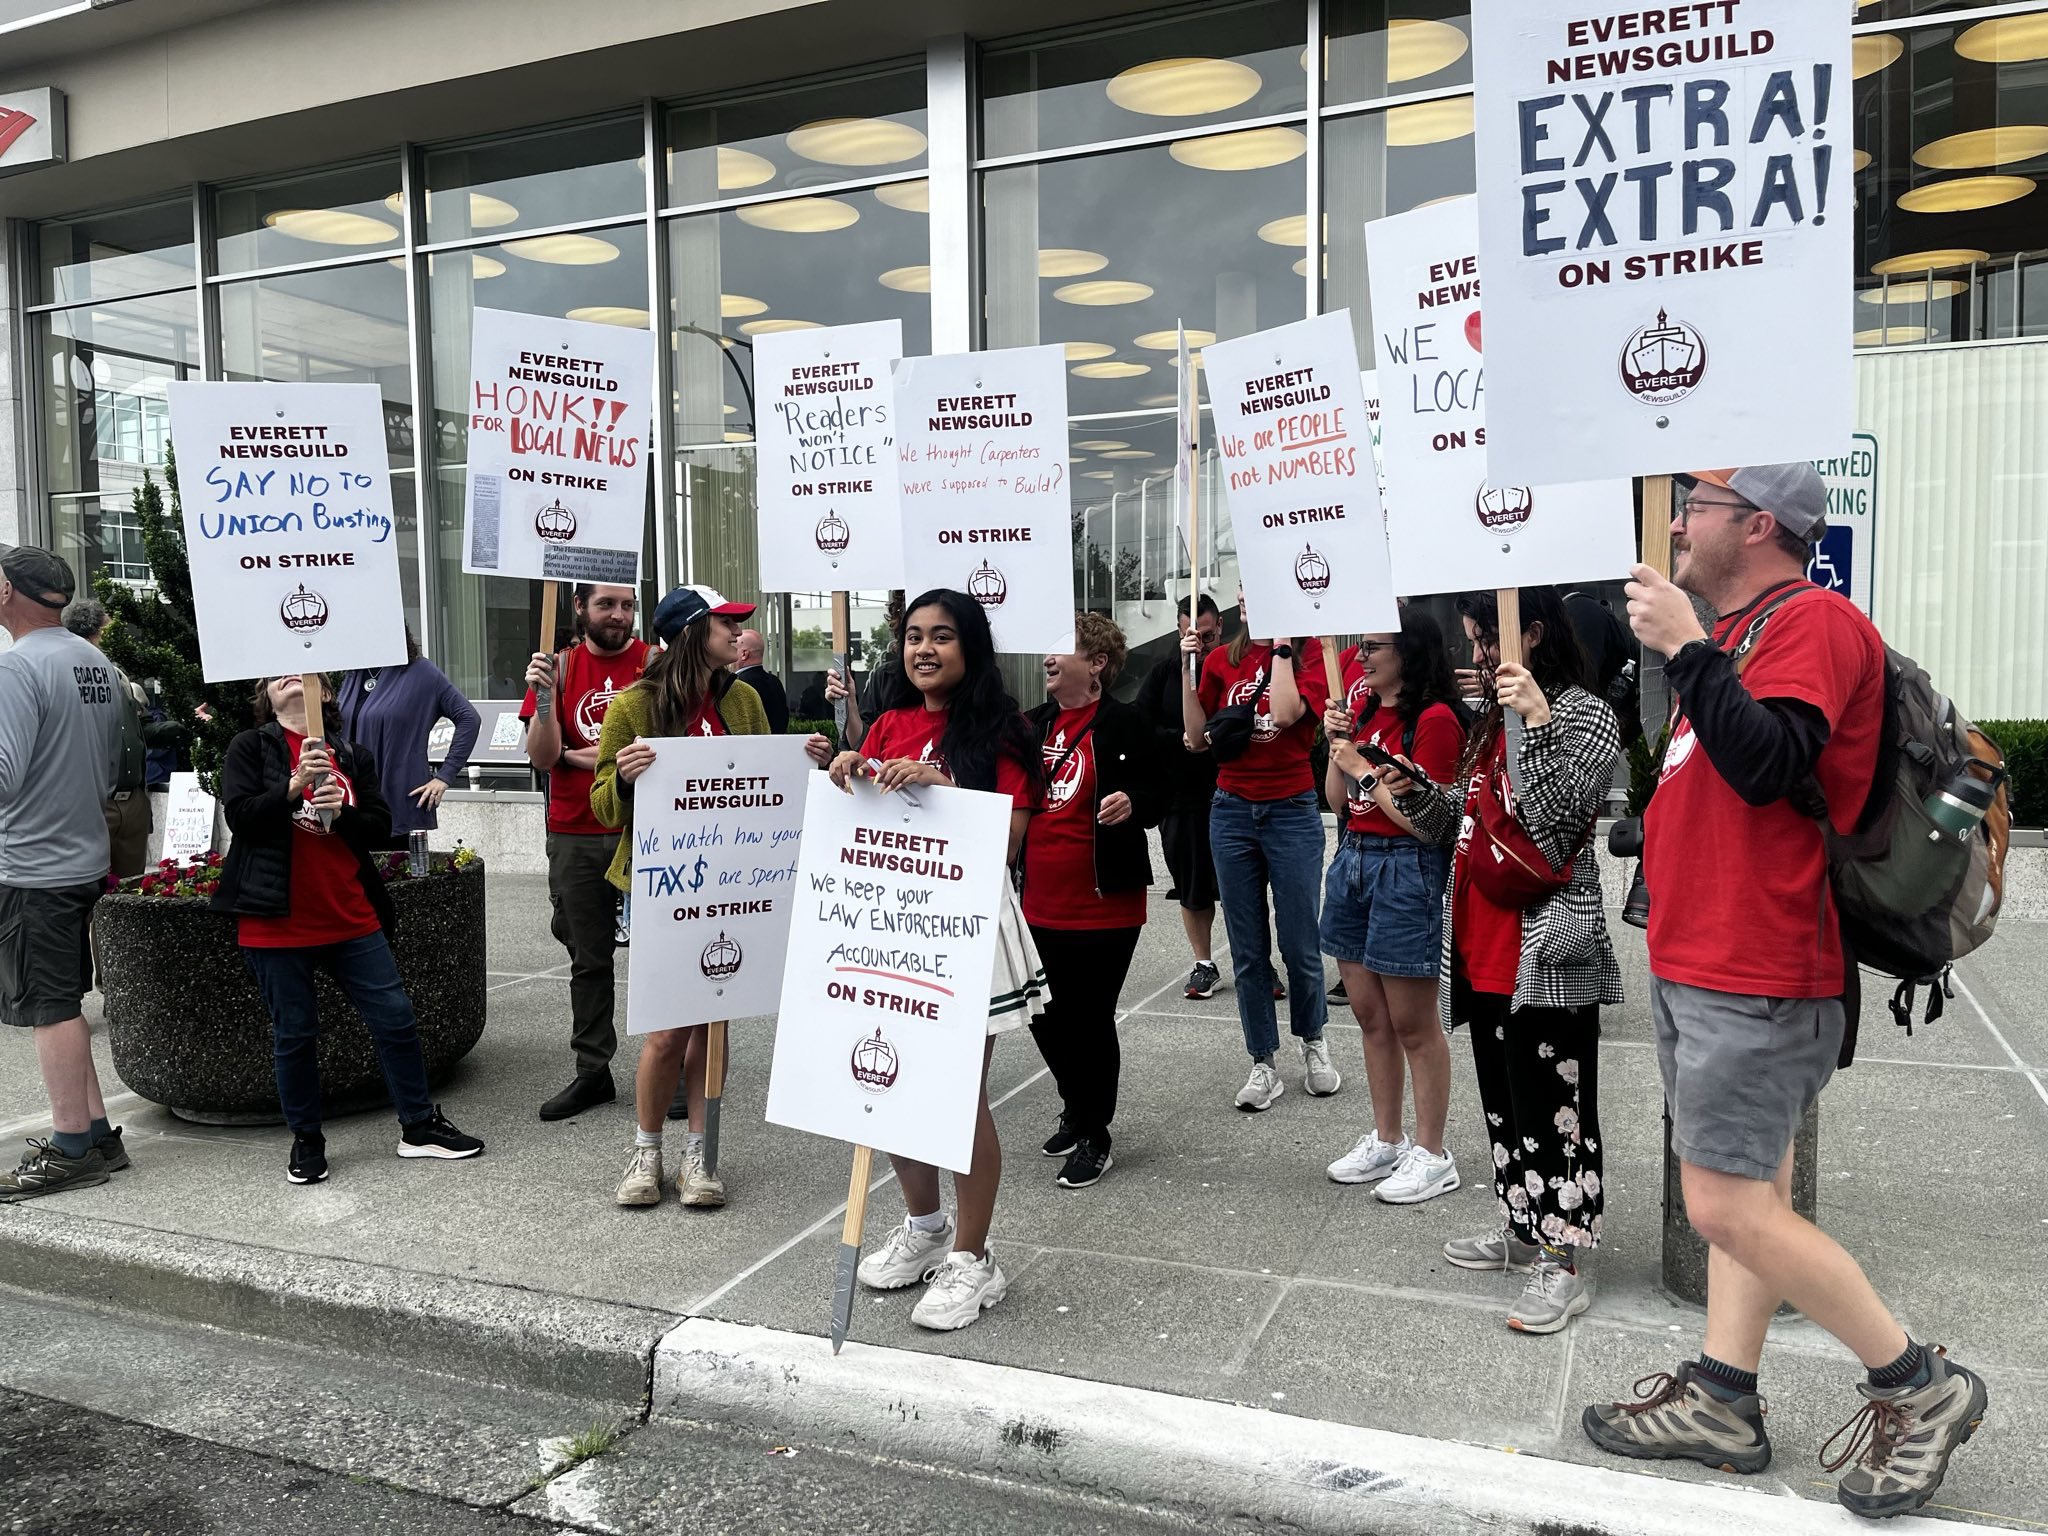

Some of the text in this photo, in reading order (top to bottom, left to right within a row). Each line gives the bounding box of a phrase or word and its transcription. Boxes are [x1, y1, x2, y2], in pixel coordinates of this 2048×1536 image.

[1567, 0, 1740, 47] EVERETT
[1547, 30, 1774, 84] NEWSGUILD
[1518, 63, 1832, 175] EXTRA!
[1522, 144, 1832, 256] EXTRA!
[1559, 241, 1763, 288] ON STRIKE
[1384, 322, 1439, 365] WE
[520, 351, 604, 374] EVERETT
[792, 362, 860, 380] EVERETT
[508, 366, 618, 392] NEWSGUILD
[784, 377, 874, 397] NEWSGUILD
[1245, 368, 1314, 395] EVERETT
[1635, 373, 1693, 389] EVERETT
[475, 380, 629, 433] HONK!!
[937, 394, 1017, 412] EVERETT
[1240, 385, 1331, 416] NEWSGUILD
[1641, 388, 1687, 403] NEWSGUILD
[472, 415, 505, 432] FOR
[928, 412, 1033, 431] NEWSGUILD
[230, 427, 328, 440] EVERETT
[1222, 435, 1247, 459] We
[1254, 429, 1275, 450] are
[1277, 408, 1345, 443] PEOPLE
[1432, 431, 1466, 452] ON
[220, 444, 348, 459] NEWSGUILD
[899, 443, 918, 463] We
[926, 443, 972, 468] thought
[508, 468, 608, 491] ON STRIKE
[1231, 469, 1262, 490] not
[1268, 447, 1357, 485] NUMBERS
[206, 466, 276, 502] SAY
[290, 472, 330, 496] NO
[792, 480, 873, 496] ON STRIKE
[1263, 504, 1346, 529] ON STRIKE
[1486, 511, 1525, 524] EVERETT
[541, 530, 570, 538] EVERETT
[820, 540, 845, 549] EVERETT
[938, 527, 1031, 544] ON STRIKE
[240, 553, 355, 570] ON STRIKE
[1302, 579, 1328, 589] EVERETT
[289, 617, 322, 627] EVERETT
[685, 777, 769, 792] EVERETT
[674, 794, 784, 811] NEWSGUILD
[638, 828, 660, 856] We
[672, 824, 723, 850] watch
[735, 827, 763, 845] how
[854, 827, 949, 856] EVERETT
[637, 854, 798, 897] TAX$ are spent
[840, 847, 963, 881] NEWSGUILD
[811, 873, 934, 909] We keep your
[673, 900, 772, 921] ON STRIKE
[819, 901, 988, 939] LAW ENFORCEMENT
[707, 965, 735, 975] EVERETT
[827, 983, 939, 1020] ON STRIKE
[857, 1071, 890, 1084] EVERETT
